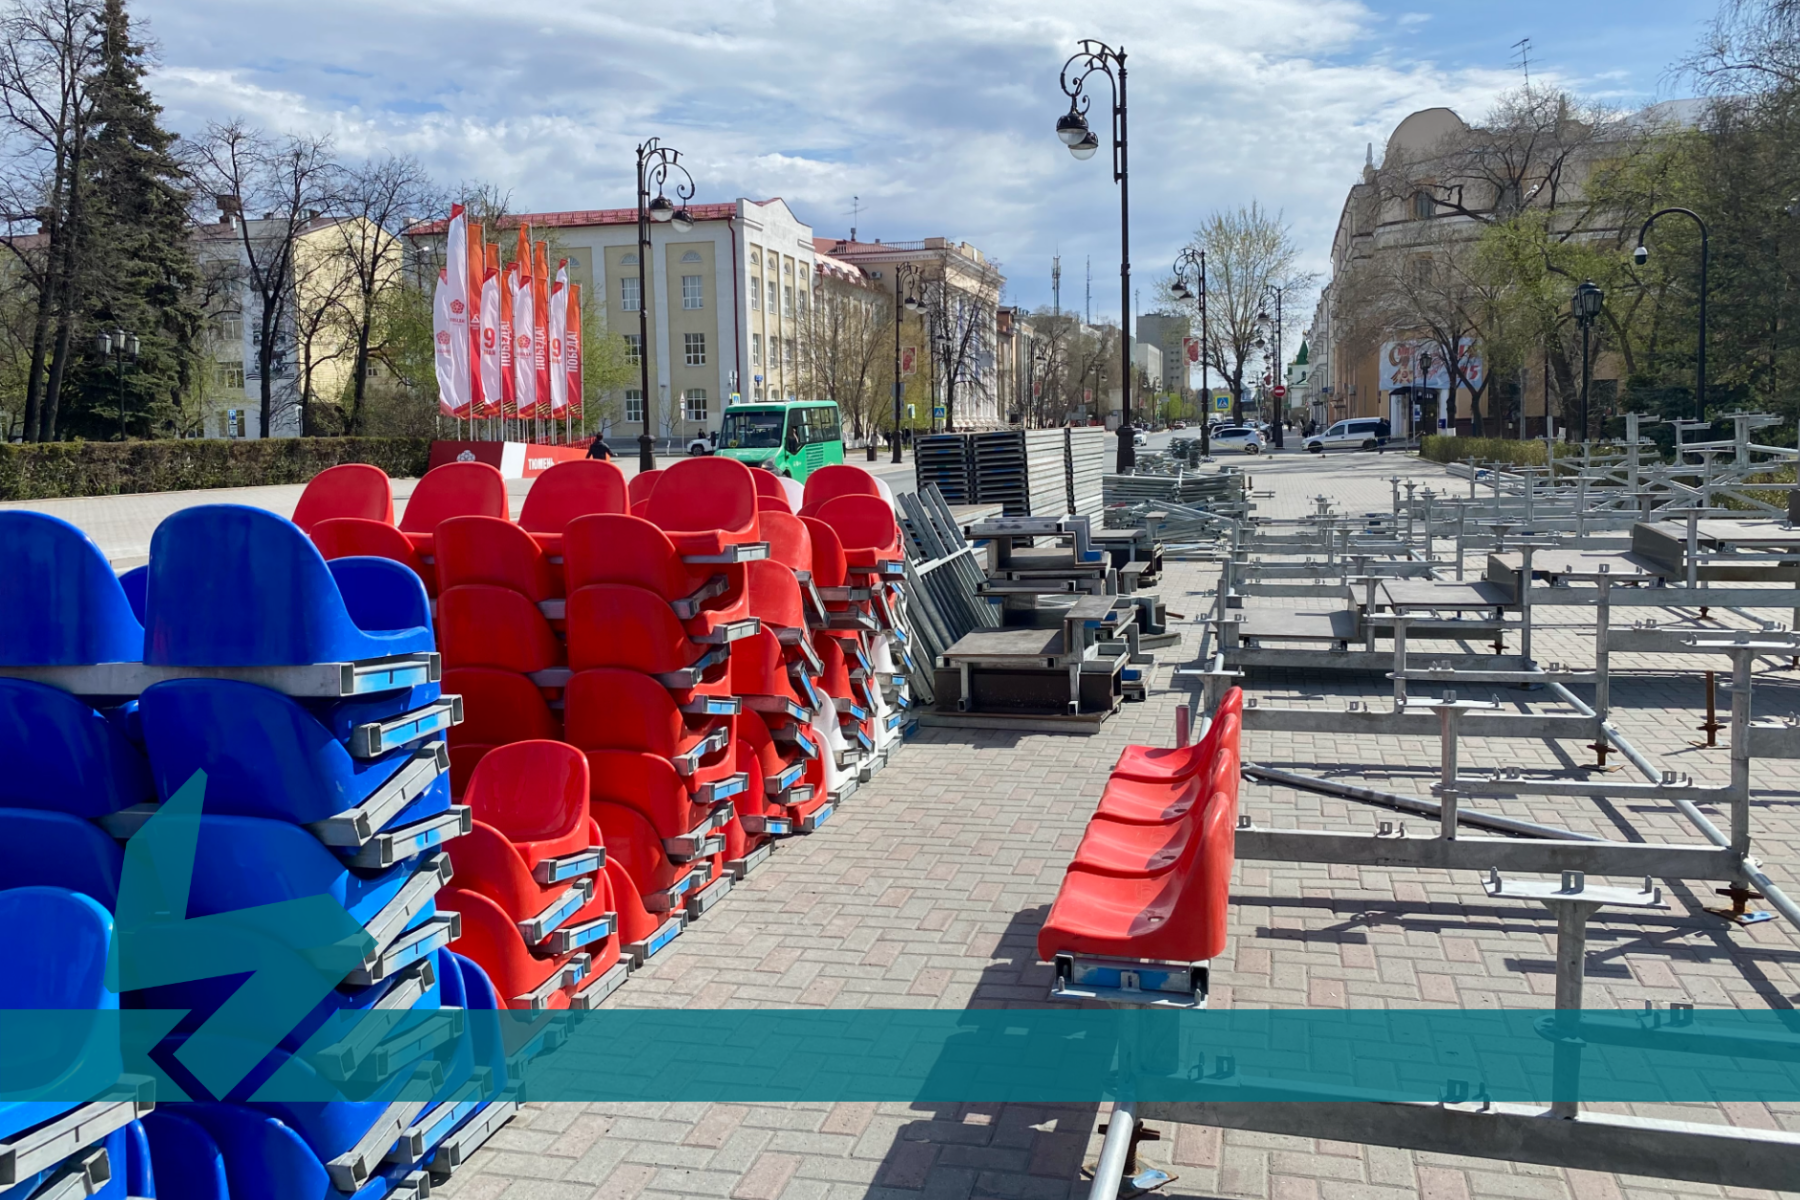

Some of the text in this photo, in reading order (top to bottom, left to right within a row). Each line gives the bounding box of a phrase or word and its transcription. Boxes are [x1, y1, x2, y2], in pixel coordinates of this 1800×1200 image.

[484, 327, 496, 349] 9
[552, 338, 562, 357] 9
[567, 331, 580, 372] ПОБЕДА!
